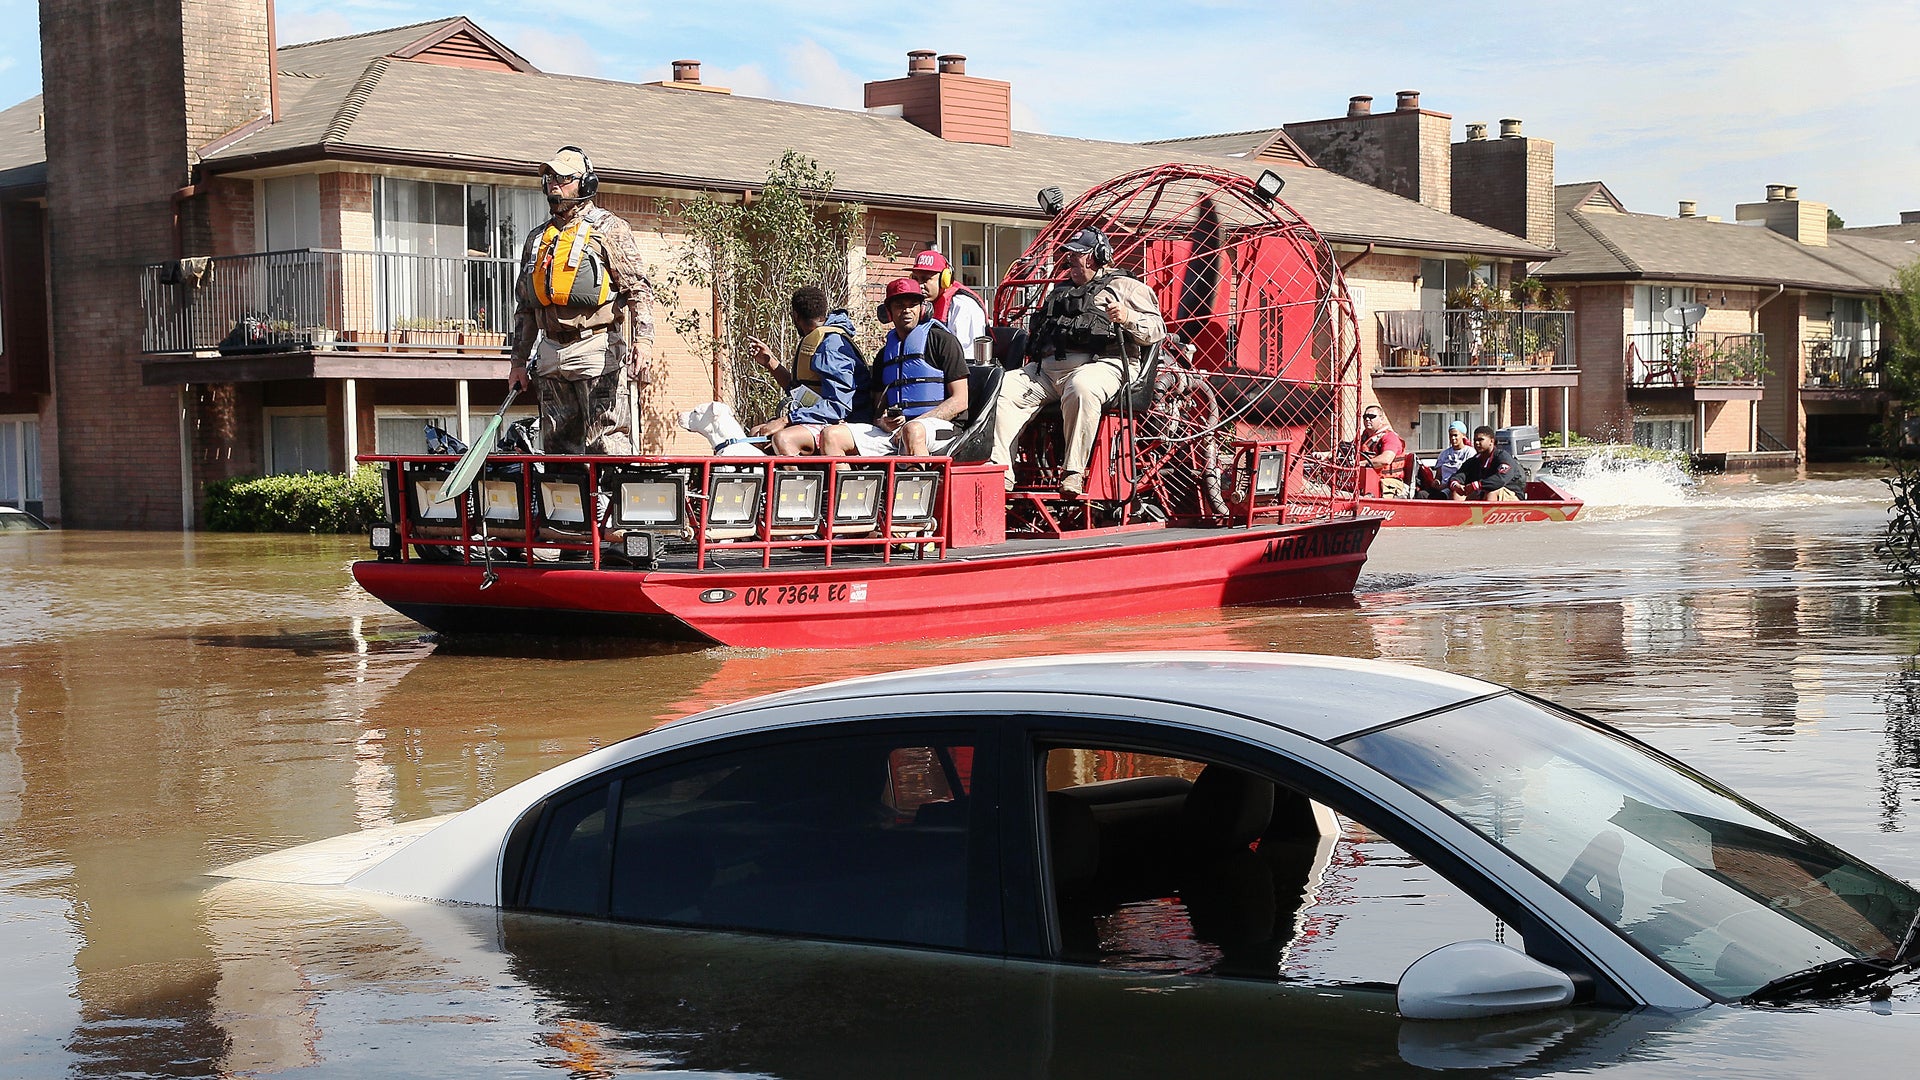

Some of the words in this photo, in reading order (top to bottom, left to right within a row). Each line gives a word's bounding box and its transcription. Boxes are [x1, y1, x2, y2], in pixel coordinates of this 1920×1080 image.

[1360, 506, 1396, 521] Rescue
[1259, 530, 1365, 564] AIRRANGER
[745, 587, 769, 606] OK
[777, 585, 819, 604] 7364
[828, 584, 847, 602] EC
